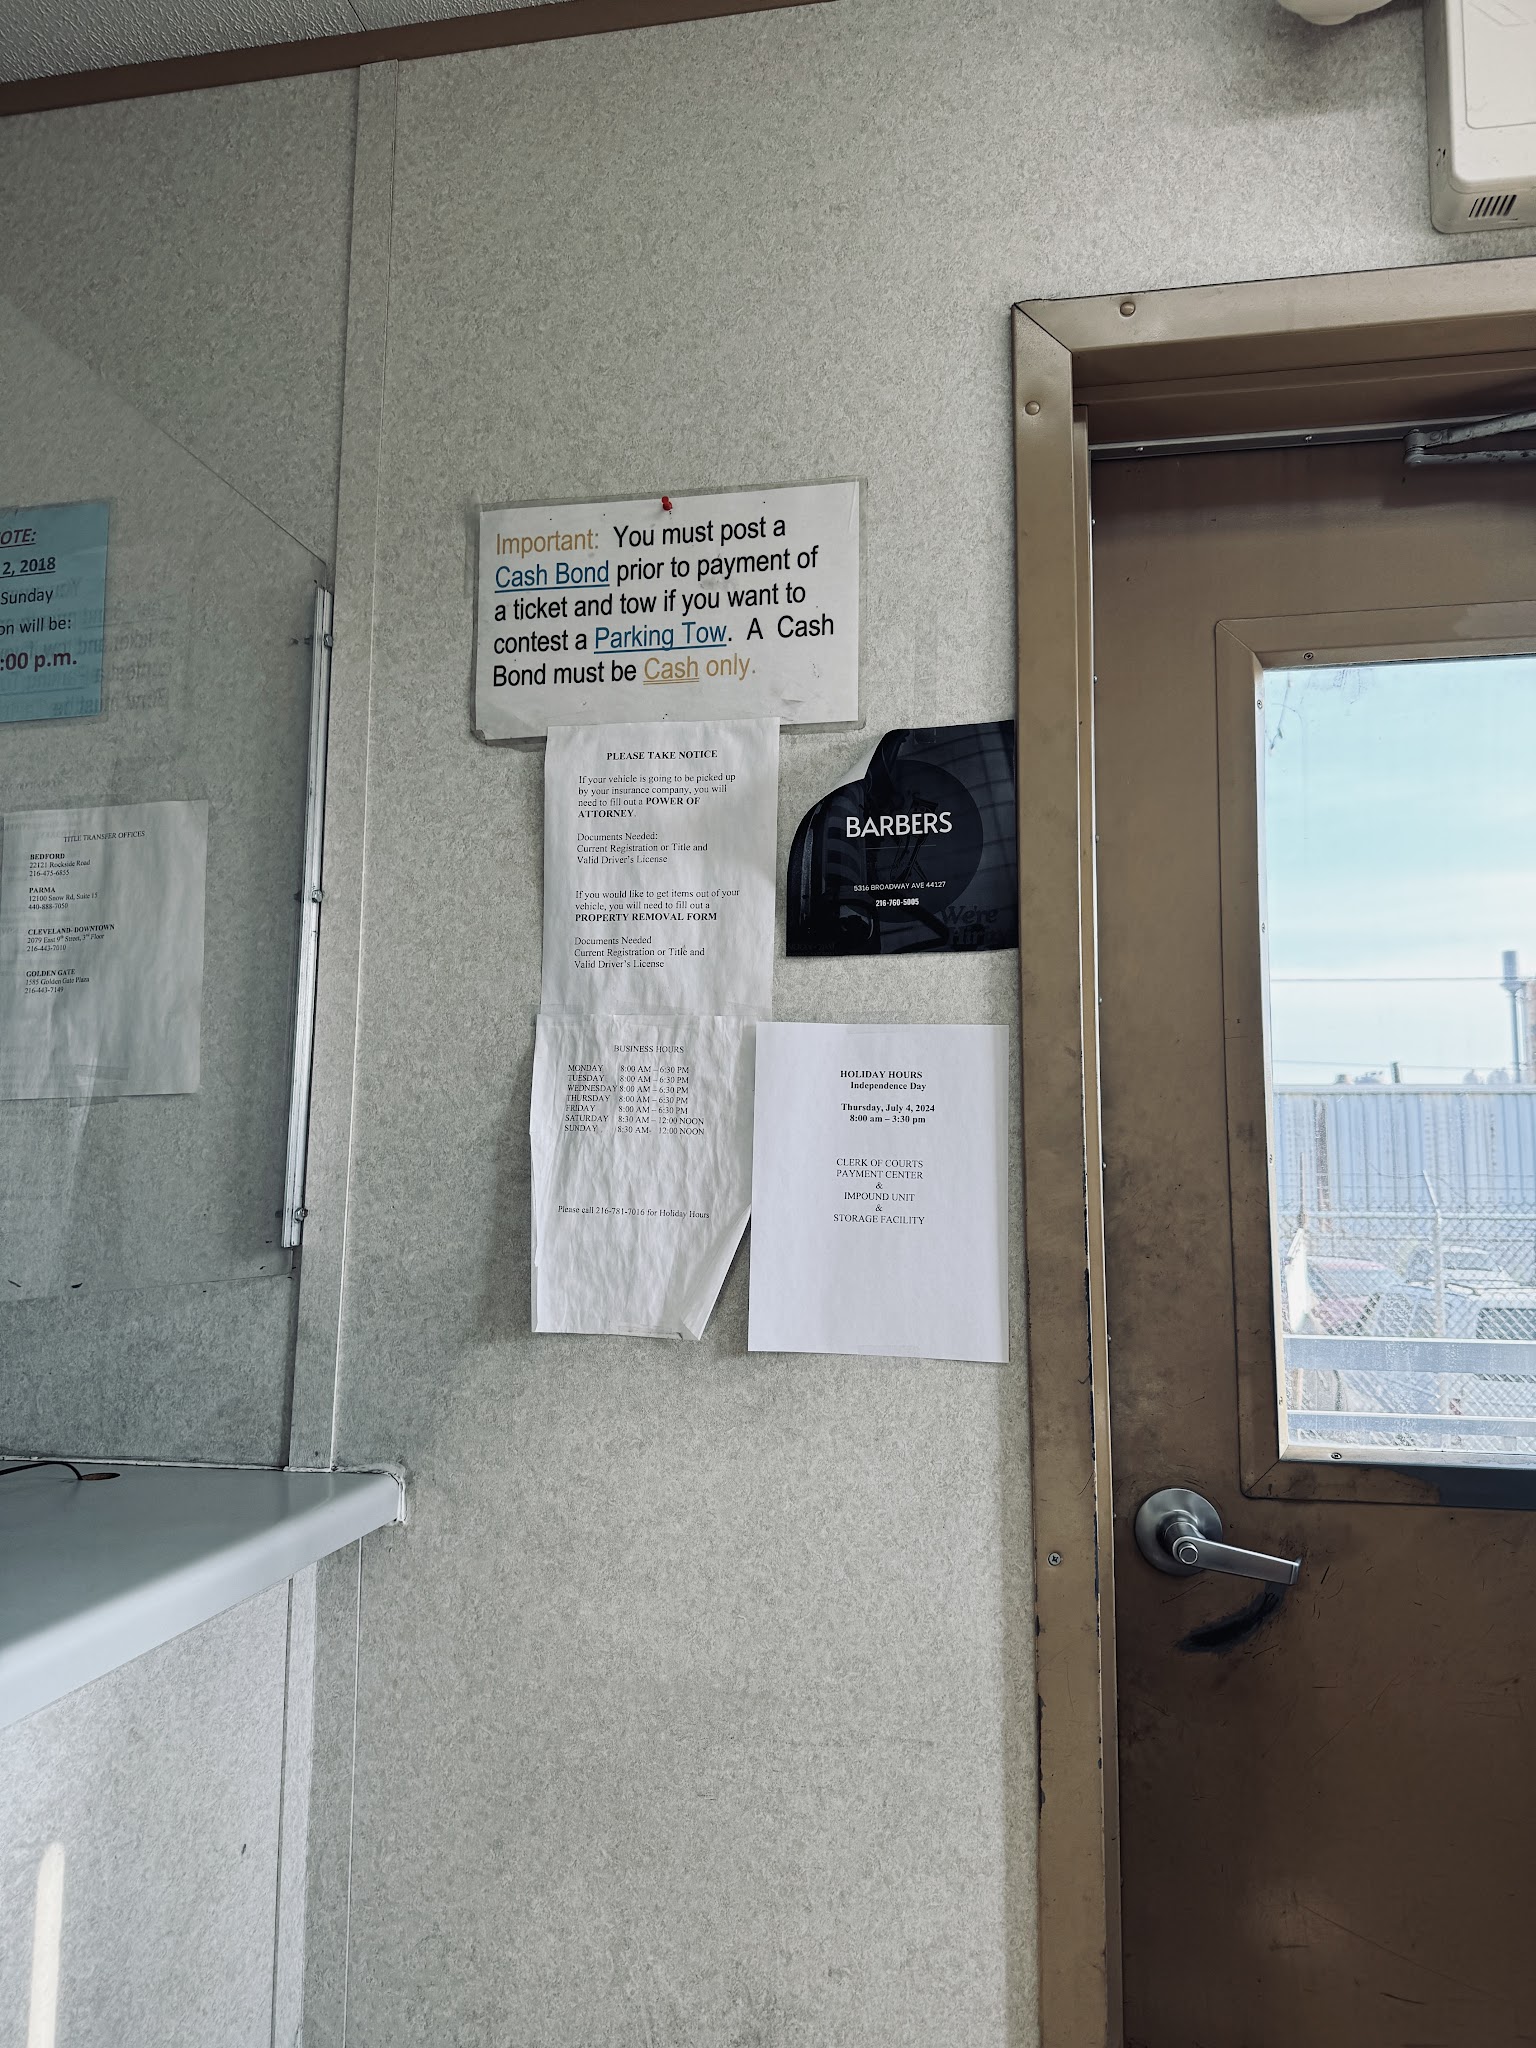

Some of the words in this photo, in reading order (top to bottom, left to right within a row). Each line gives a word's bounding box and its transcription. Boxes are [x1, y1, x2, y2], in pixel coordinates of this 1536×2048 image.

[0, 528, 37, 543] OTE:
[496, 529, 599, 558] Important:
[613, 525, 654, 548] You
[663, 520, 714, 545] must
[721, 516, 766, 546] post
[773, 520, 785, 536] a
[2, 561, 15, 576] 2,
[19, 556, 56, 573] 2018
[496, 564, 547, 588] Cash
[556, 560, 608, 584] Bond
[617, 558, 664, 586] prior
[670, 557, 690, 578] to
[698, 548, 790, 581] payment
[797, 545, 819, 568] of
[0, 587, 54, 605] Sunday
[495, 605, 506, 621] a
[513, 596, 568, 620] ticket
[574, 593, 612, 617] and
[620, 593, 656, 614] tow
[664, 589, 676, 612] if
[682, 592, 719, 616] you
[727, 583, 779, 607] want
[786, 582, 806, 603] to
[19, 617, 44, 634] will
[48, 616, 71, 631] be:
[494, 630, 568, 654] contest
[575, 634, 587, 650] a
[594, 626, 674, 651] Parking
[682, 622, 732, 643] Tow.
[746, 618, 764, 640] A
[778, 613, 834, 638] Cash
[34, 652, 77, 673] p.m.
[494, 663, 546, 686] Bond
[554, 661, 604, 684] must
[612, 660, 636, 682] be
[645, 656, 698, 679] Cash
[706, 653, 755, 680] only.
[607, 751, 645, 760] PLEASE
[647, 751, 676, 759] TAKE
[679, 750, 718, 759] NOTICE
[579, 775, 587, 784] If
[588, 777, 607, 785] your
[608, 774, 637, 783] vehicle
[648, 776, 672, 785] going
[684, 774, 694, 782] be
[696, 772, 723, 784] picked
[725, 774, 736, 783] up
[578, 787, 589, 796] by
[591, 788, 610, 797] your
[611, 787, 650, 795] insurance
[651, 787, 692, 796] company,
[694, 787, 709, 795] you
[711, 784, 727, 793] will
[578, 798, 597, 807] need
[610, 798, 621, 806] fill
[646, 797, 684, 805] POWER
[686, 797, 701, 805] OF
[579, 809, 636, 818] ATTORNEY.
[846, 812, 952, 837] BARBERS
[577, 833, 623, 841] Documents
[625, 832, 658, 841] Needed:
[576, 844, 608, 853] Current
[610, 844, 658, 854] Registration
[671, 843, 691, 851] Title
[692, 843, 708, 851] and
[577, 855, 599, 864] Valid
[601, 855, 634, 864] Driver's
[636, 855, 668, 863] License
[575, 913, 629, 922] PROPERTY
[632, 912, 684, 921] REMOVAL
[687, 912, 717, 921] FORM
[614, 1045, 654, 1053] BUSINESS
[656, 1045, 684, 1054] HOURS
[568, 1064, 604, 1072] MONDAY
[620, 1064, 636, 1073] 8:00
[637, 1065, 651, 1073] AM
[659, 1066, 675, 1074] 6:30
[677, 1066, 689, 1074] PM
[840, 1070, 886, 1078] HOLIDAY
[888, 1071, 923, 1079] HOURS
[567, 1074, 605, 1082] TUESDAY
[567, 1084, 618, 1092] WEDNESDAY
[851, 1081, 908, 1091] Independence
[910, 1082, 927, 1092] Day
[567, 1094, 609, 1102] THURSDAY
[565, 1104, 596, 1112] FRIDAY
[841, 1103, 884, 1112] Thursday,
[885, 1104, 904, 1113] July
[905, 1104, 914, 1112] 4,
[915, 1104, 935, 1112] 2024
[565, 1114, 609, 1122] SATURDAY
[618, 1115, 634, 1123] 8:30
[635, 1116, 650, 1124] AM
[659, 1116, 678, 1125] 12:00
[679, 1117, 704, 1125] NOON
[849, 1114, 868, 1122] 8:00
[892, 1115, 910, 1123] 3:30
[912, 1117, 926, 1125] pm
[564, 1124, 598, 1132] SUNDAY
[617, 1125, 633, 1133] 8:30
[635, 1126, 651, 1134] AM-
[659, 1127, 678, 1135] 12:00
[679, 1127, 705, 1136] NOON
[836, 1158, 868, 1167] CLERK
[870, 1159, 883, 1167] OF
[885, 1159, 924, 1168] COURTS
[836, 1169, 884, 1178] PAYMENT
[885, 1170, 923, 1179] CENTER
[875, 1182, 883, 1190] &
[844, 1192, 890, 1201] IMPOUND
[891, 1193, 915, 1202] UNIT
[558, 1205, 580, 1214] Please
[581, 1206, 594, 1214] call
[647, 1208, 657, 1216] for
[659, 1209, 686, 1219] Holiday
[689, 1210, 710, 1219] Hours
[833, 1213, 878, 1223] STORAGE
[880, 1215, 925, 1225] FACILITY
